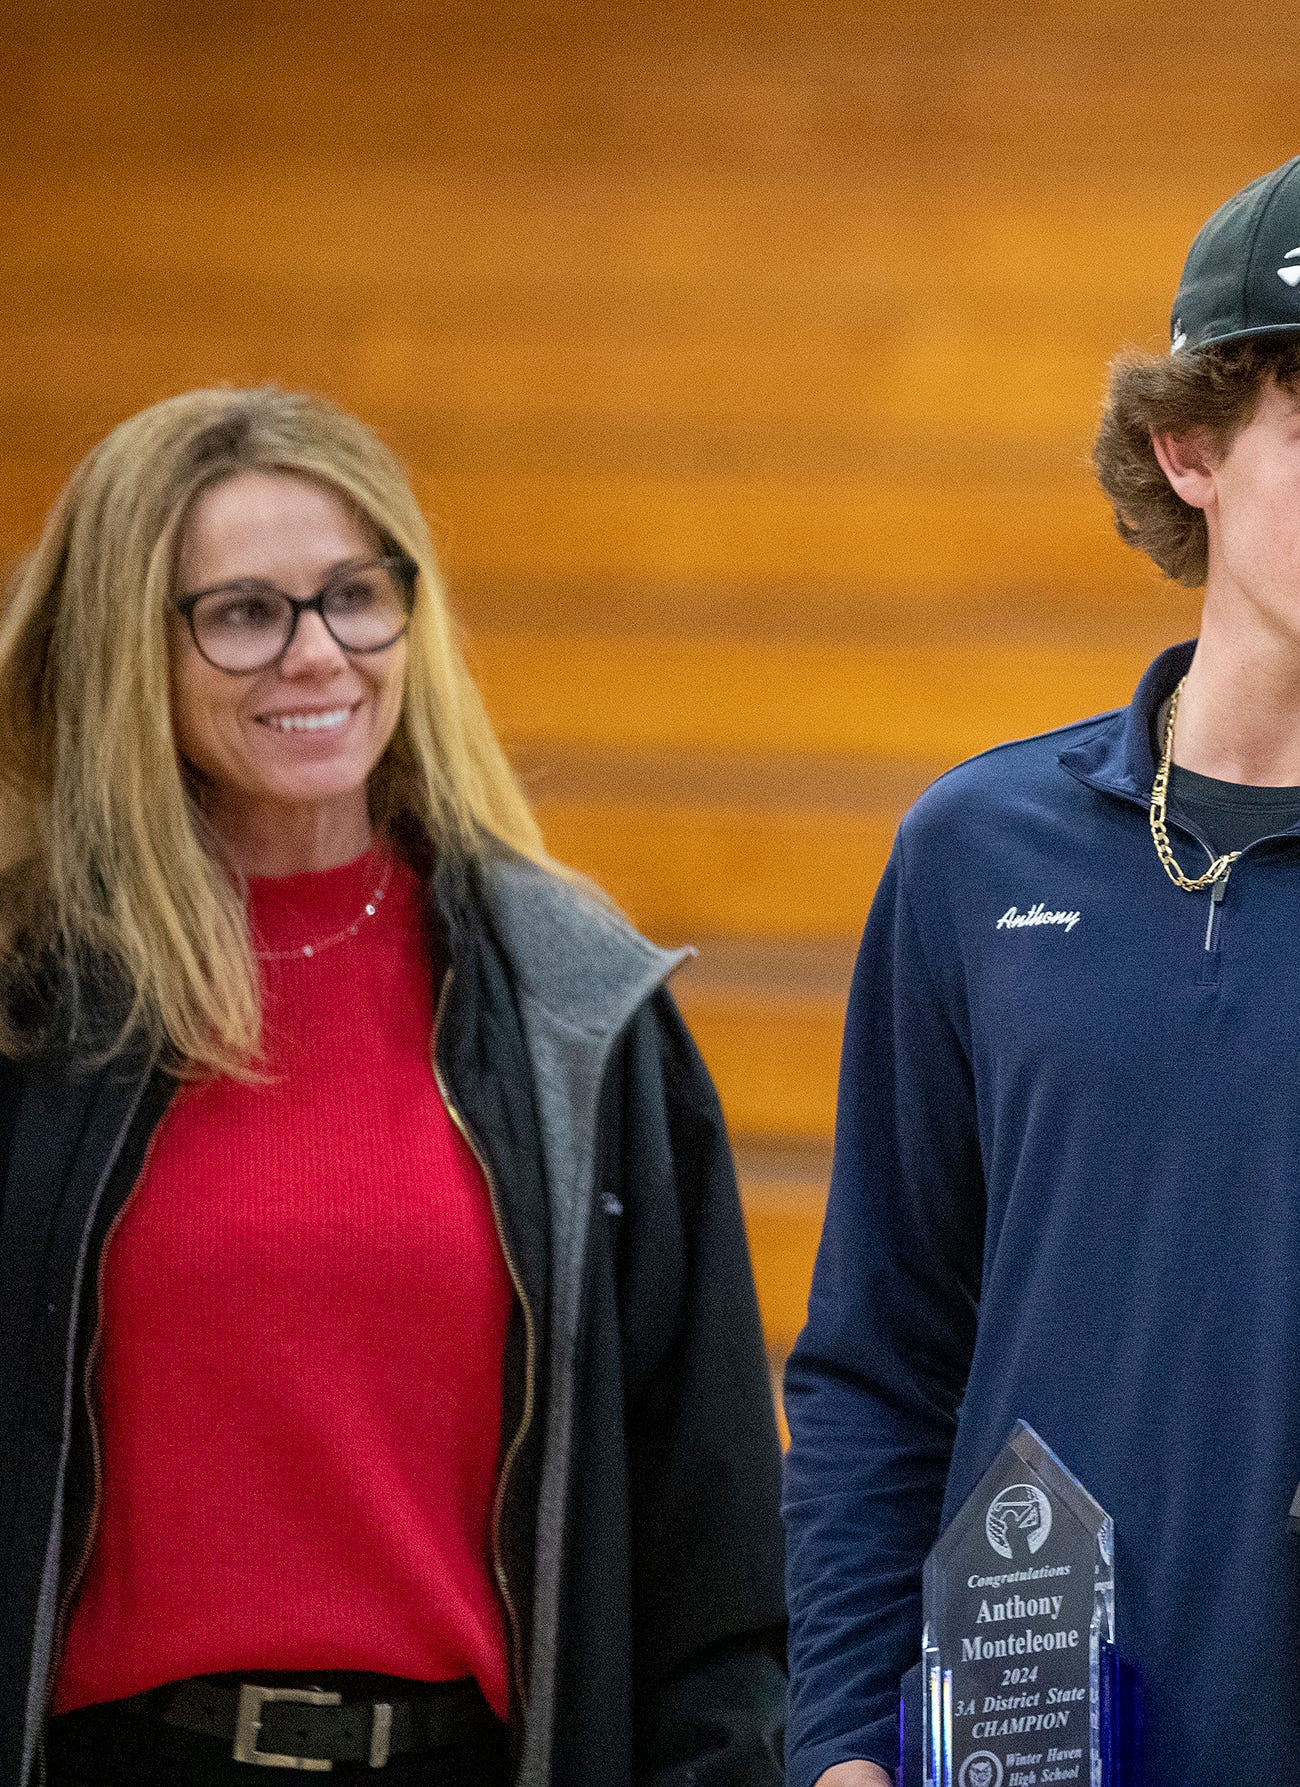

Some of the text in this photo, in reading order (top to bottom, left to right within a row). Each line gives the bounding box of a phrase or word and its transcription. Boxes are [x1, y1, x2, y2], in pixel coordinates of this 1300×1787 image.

[996, 903, 1080, 932] Anthony
[967, 1564, 1071, 1588] Congratulations
[976, 1595, 1063, 1624] Anthony
[961, 1629, 1079, 1662] Monteleone
[1001, 1666, 1039, 1686] 2024
[954, 1687, 1086, 1717] 3A District State
[971, 1710, 1070, 1739] CHAMPION
[1005, 1748, 1082, 1767] Winter Haven
[1008, 1765, 1080, 1787] High School
